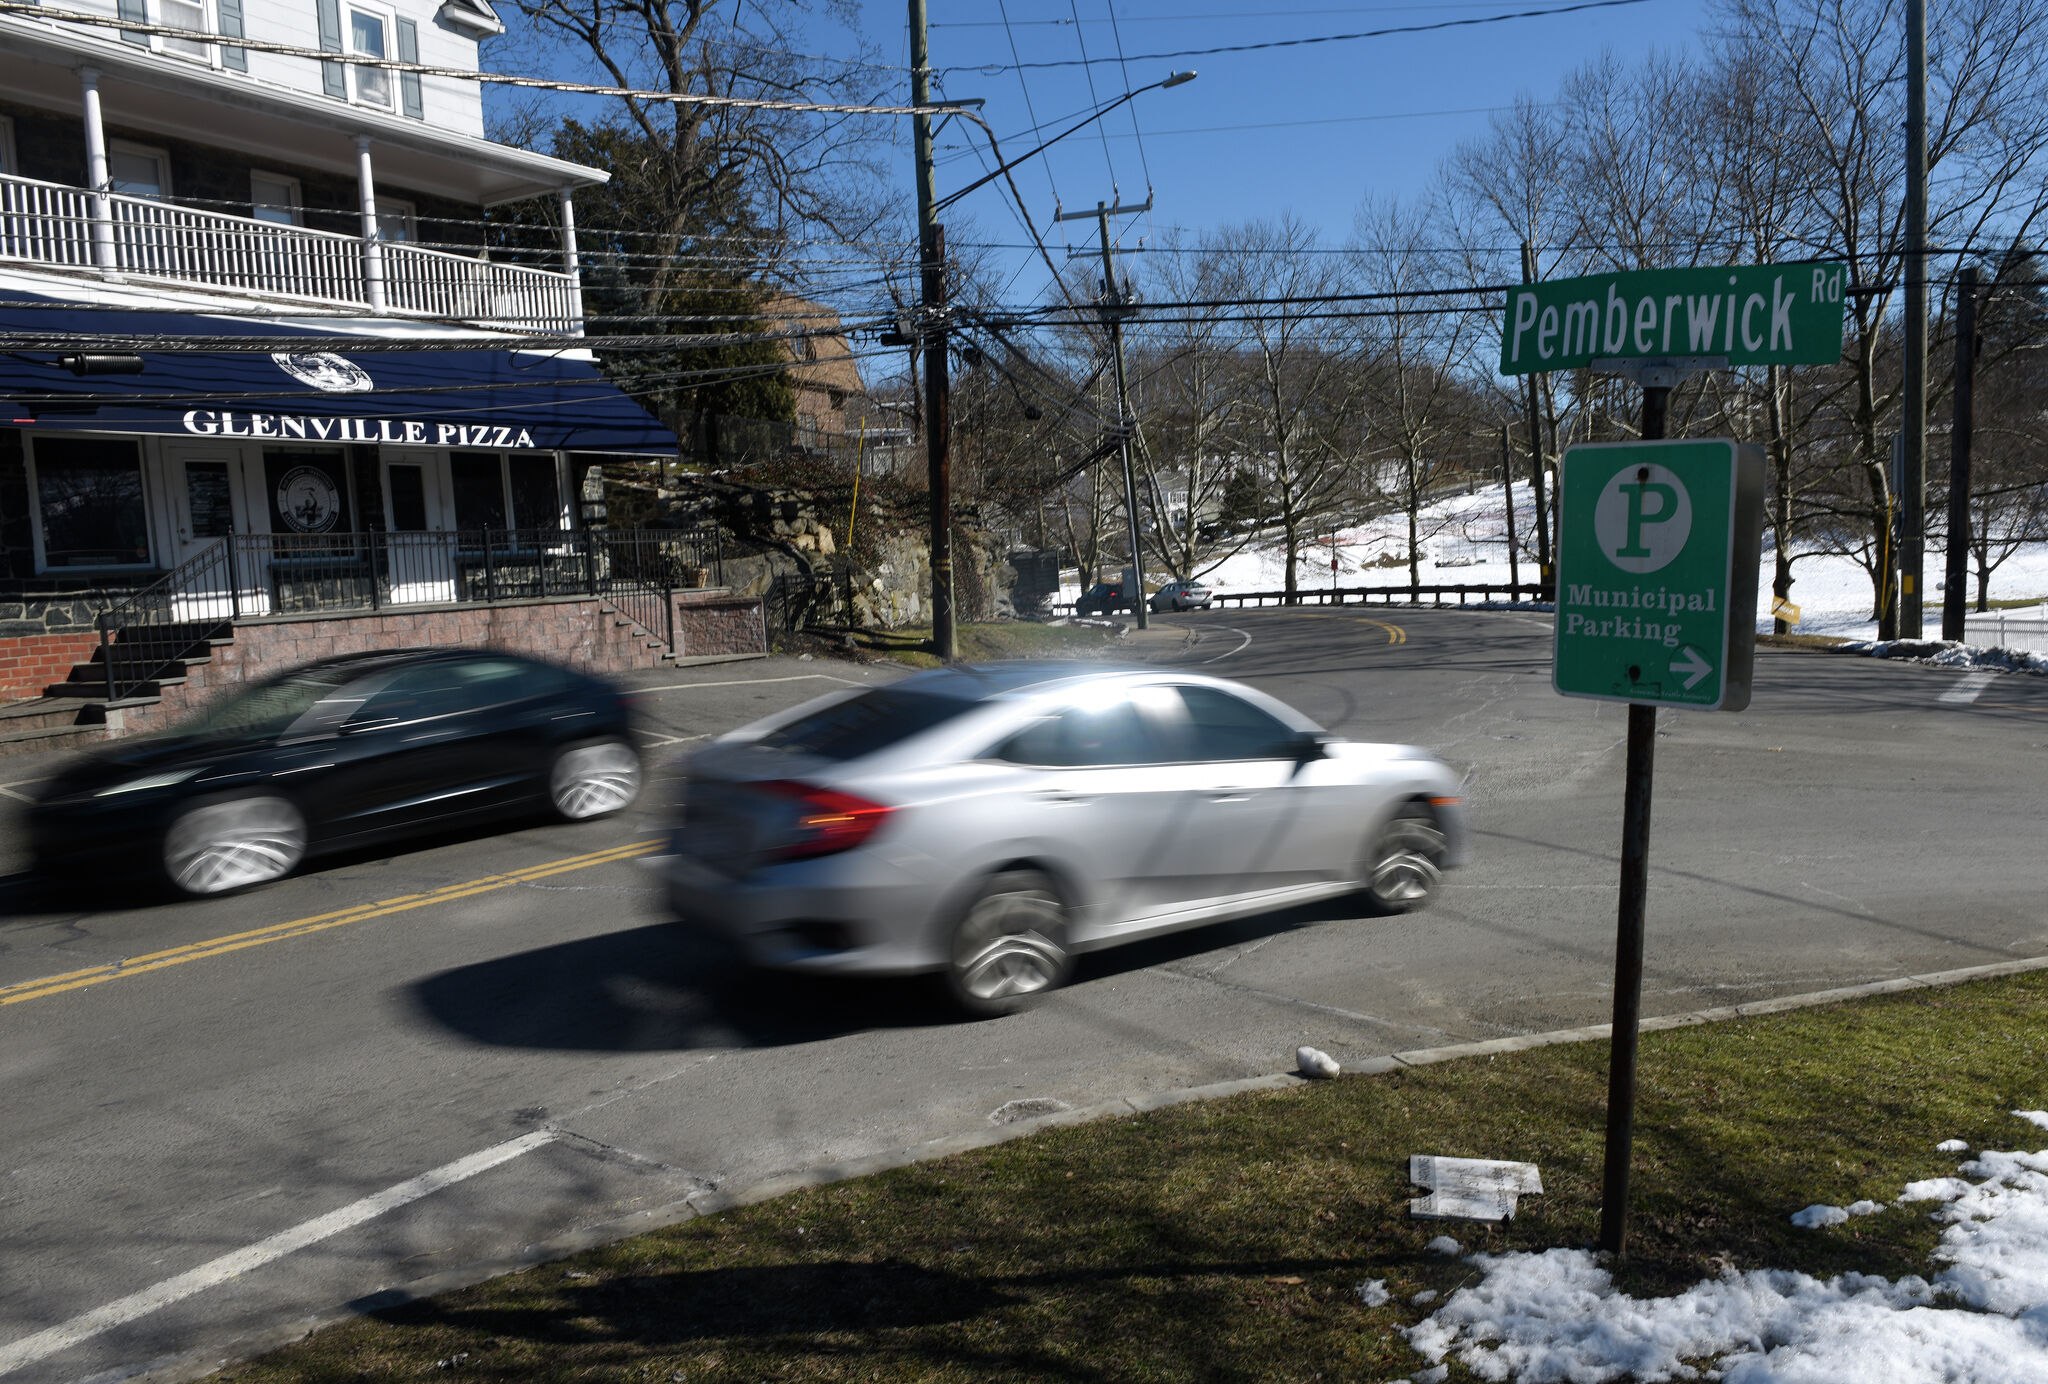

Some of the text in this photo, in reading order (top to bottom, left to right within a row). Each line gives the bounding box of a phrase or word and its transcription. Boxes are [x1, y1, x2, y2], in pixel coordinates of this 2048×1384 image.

[1511, 268, 1841, 363] Pemberwick Rd
[183, 410, 535, 448] GLENVILLE PIZZA
[1616, 483, 1679, 558] P
[1567, 584, 1717, 616] Municipal
[1565, 613, 1682, 647] Parking
